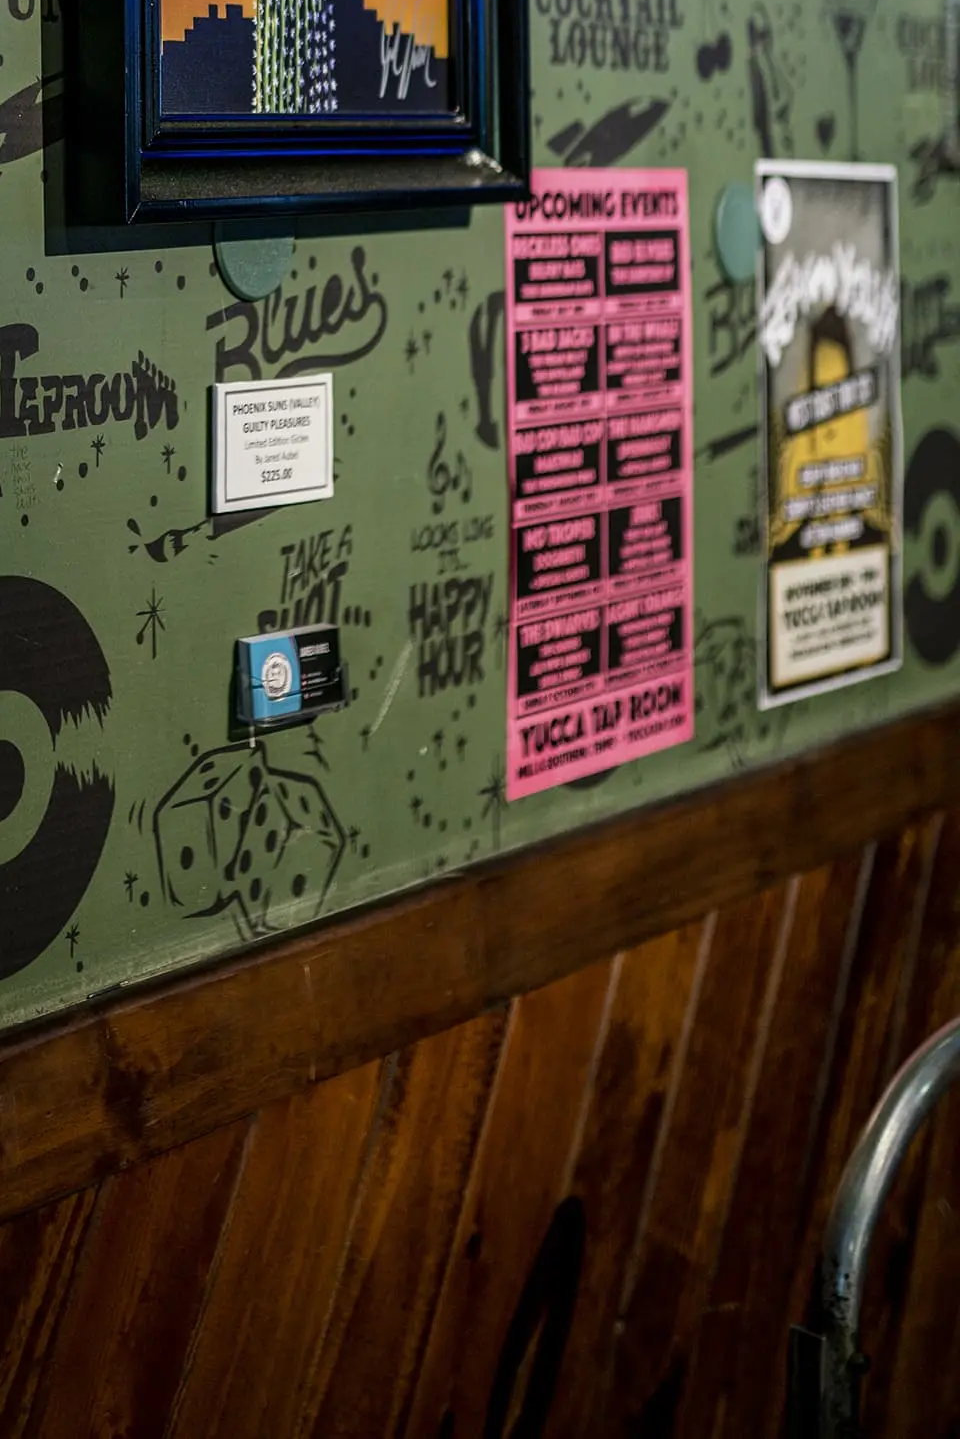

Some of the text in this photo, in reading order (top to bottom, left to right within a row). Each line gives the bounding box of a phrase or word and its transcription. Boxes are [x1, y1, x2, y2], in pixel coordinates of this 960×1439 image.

[548, 18, 671, 72] LOUNGE
[515, 191, 678, 222] UPCOMING EVENTS
[206, 246, 389, 383] Blues
[232, 401, 266, 416] PHOENIX
[268, 399, 288, 413] SUNS
[242, 415, 311, 434] GUILTY PLEASURES
[260, 467, 293, 483] $225.00
[280, 523, 353, 605] TAKE A
[408, 569, 495, 641] HAPPY
[417, 628, 487, 699] HOUR
[518, 680, 685, 759] YUCCA TAP ROOM
